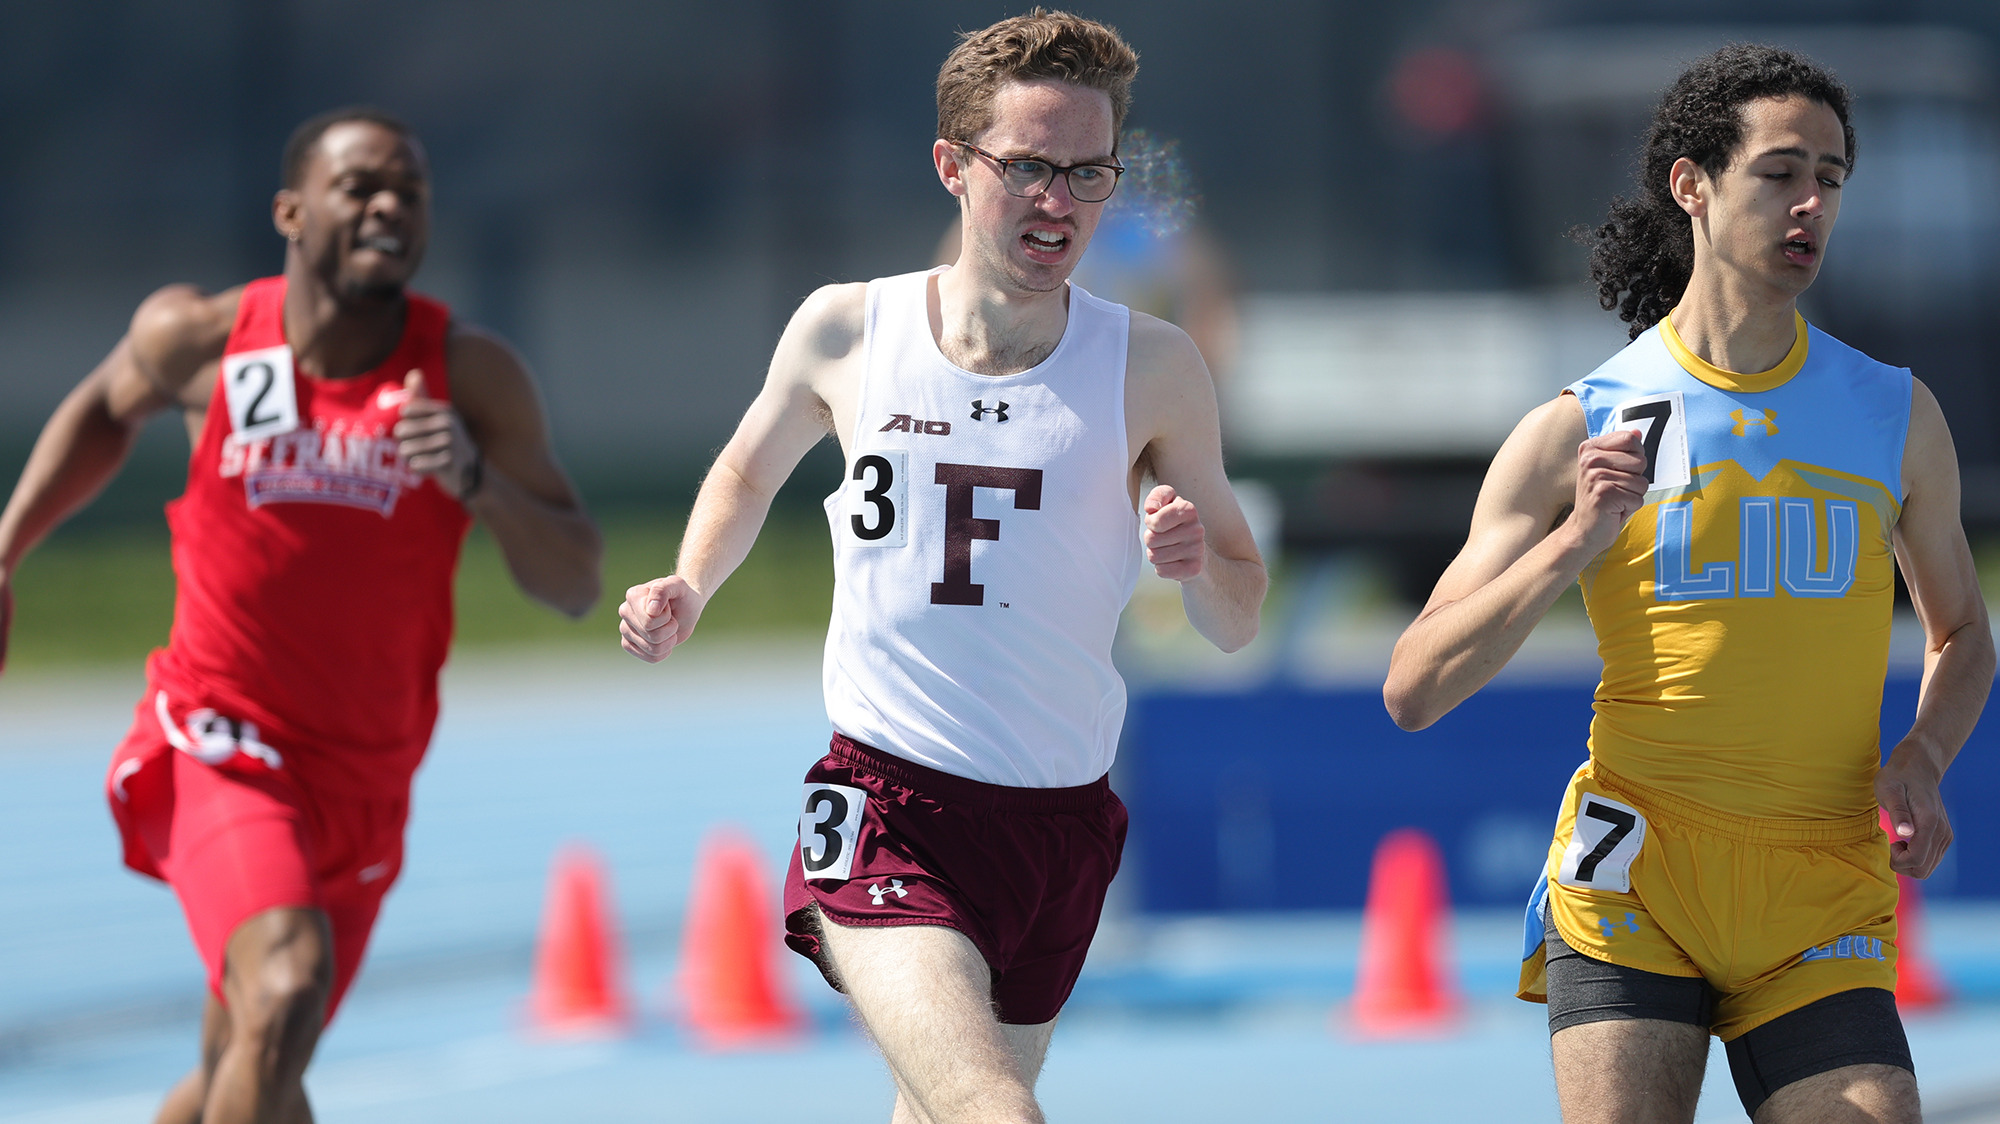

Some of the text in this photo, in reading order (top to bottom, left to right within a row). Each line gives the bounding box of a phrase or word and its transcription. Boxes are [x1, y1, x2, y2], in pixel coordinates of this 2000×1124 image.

[235, 361, 281, 429] 2
[878, 413, 951, 436] A10
[1621, 400, 1672, 484] 7
[851, 454, 895, 541] 3
[930, 462, 1043, 606] F
[1654, 496, 1860, 601] LIU
[803, 788, 849, 872] 3
[1575, 800, 1637, 883] 7
